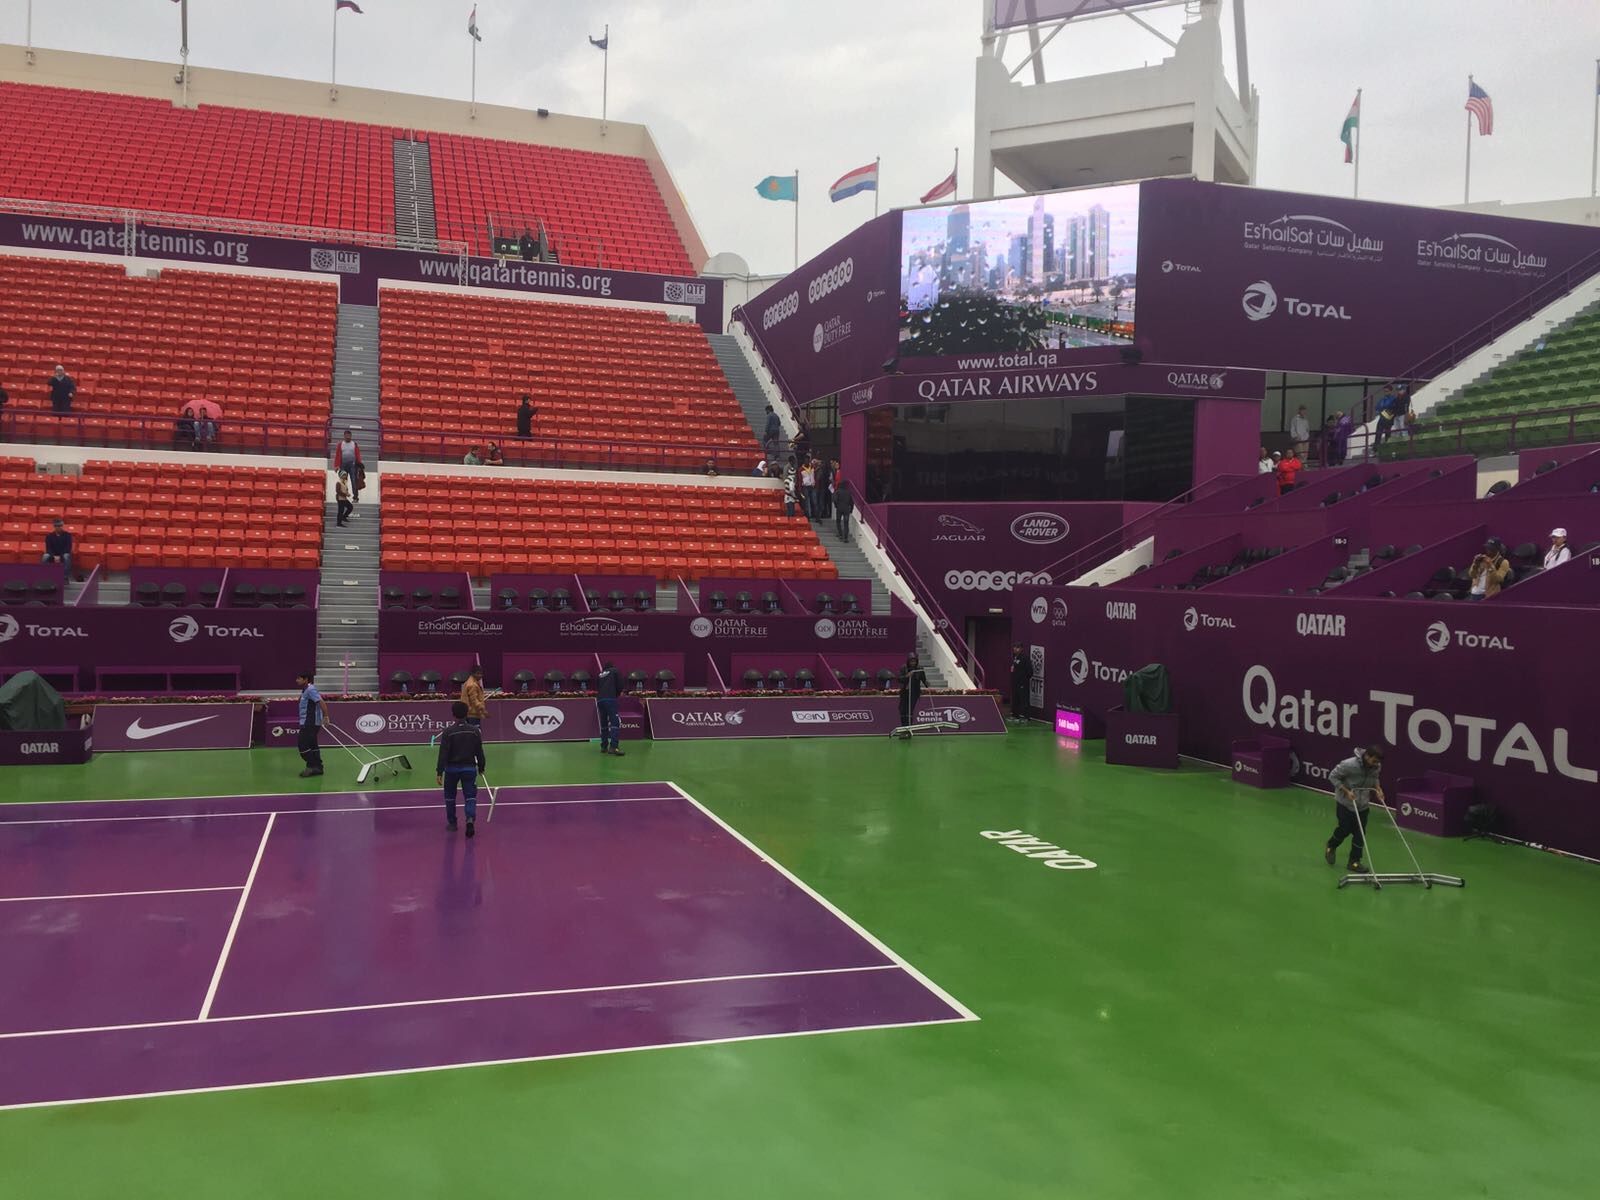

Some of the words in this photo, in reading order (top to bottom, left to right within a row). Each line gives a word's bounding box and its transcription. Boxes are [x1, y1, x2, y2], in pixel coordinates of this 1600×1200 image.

[338, 251, 358, 263] QTF
[1175, 263, 1201, 272] TOTAL
[808, 257, 854, 304] ooredoo
[687, 284, 704, 295] QTF
[1284, 297, 1351, 319] TOTAL
[957, 352, 1058, 370] www.total.qa
[1167, 372, 1208, 386] QATAR
[918, 377, 991, 401] QATAR
[998, 371, 1098, 396] AIRWAYS
[1023, 519, 1050, 528] LAND
[931, 534, 986, 542] JAGUAR
[1024, 528, 1058, 537] ROVER
[1032, 605, 1047, 615] WTA
[1106, 601, 1136, 620] QATAR
[714, 619, 748, 627] QATAR
[837, 620, 868, 629] QATAR
[1201, 614, 1236, 628] TOTAL
[1296, 613, 1346, 636] QATAR
[25, 625, 88, 637] TOTAL
[204, 625, 264, 637] TOTAL
[714, 627, 741, 635] DUTY
[744, 627, 768, 635] FREE
[837, 628, 863, 636] DUTY
[866, 628, 888, 636] FREE
[1454, 631, 1514, 650] TOTAL
[1092, 661, 1137, 683] TOTA
[388, 714, 431, 722] QATAR
[518, 715, 561, 725] WTA
[672, 712, 723, 724] QATAR
[832, 712, 870, 720] SPORTS
[388, 722, 426, 730] DUTY
[1243, 665, 1358, 738] Qatar
[1370, 690, 1598, 783] TOTAL
[1125, 734, 1157, 745] QATAR
[20, 742, 59, 754] QATAR
[1243, 764, 1259, 774] TOTAL
[1303, 761, 1330, 779] TOT
[1413, 807, 1439, 820] TOTAL
[980, 829, 1098, 869] QATAR
